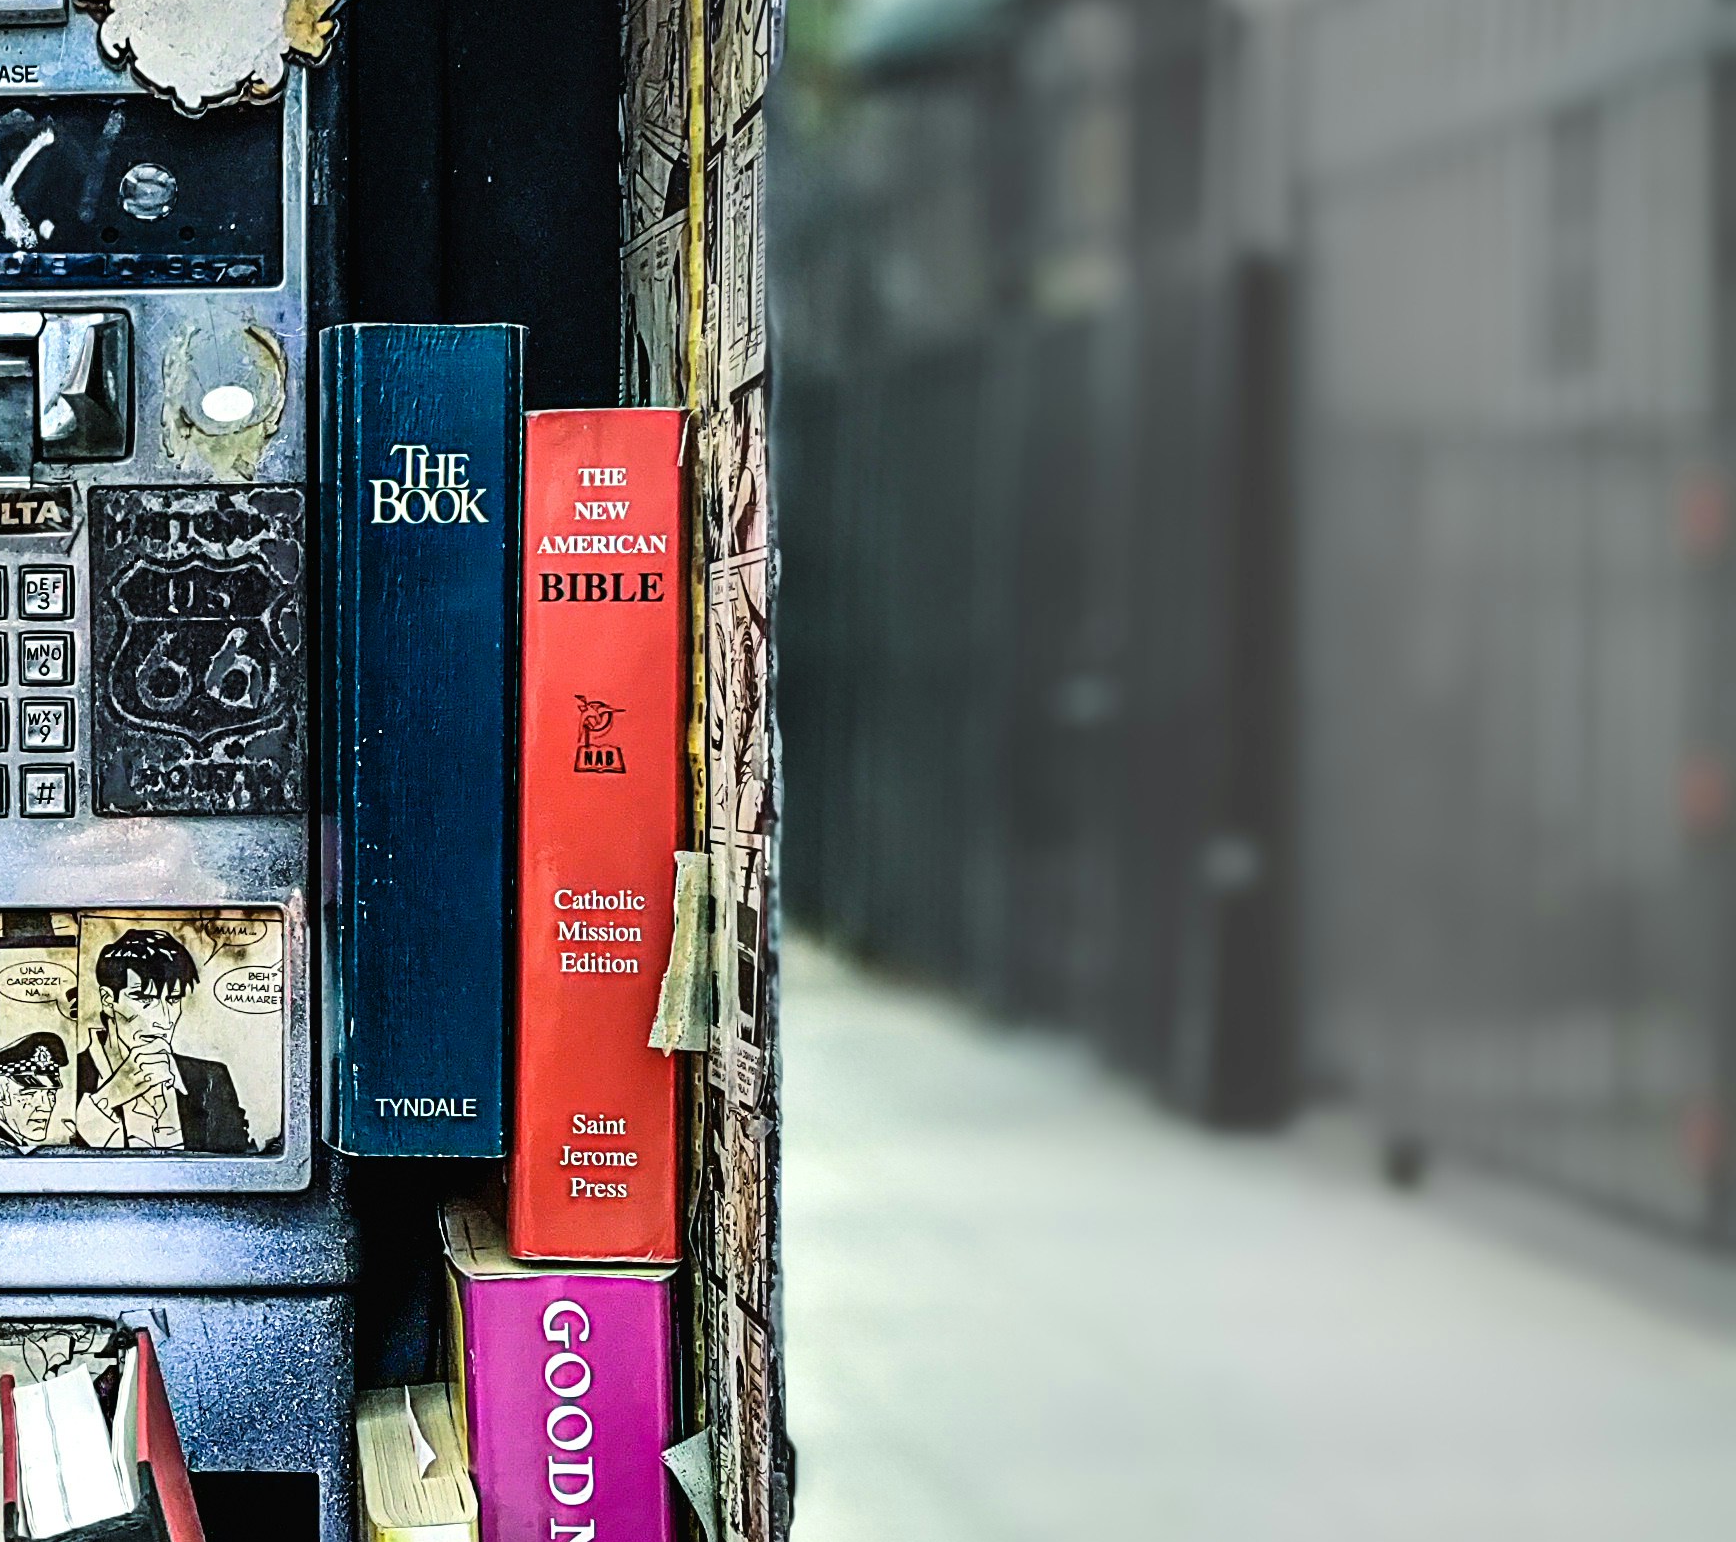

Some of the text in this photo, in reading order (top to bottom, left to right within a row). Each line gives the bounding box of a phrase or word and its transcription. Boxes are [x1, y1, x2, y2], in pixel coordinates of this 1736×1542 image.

[390, 444, 470, 489] THE
[578, 468, 627, 487] THE
[371, 480, 489, 524] BOOK
[575, 501, 630, 520] NEW
[537, 535, 667, 555] AMERICAN
[27, 578, 61, 595] DEF
[538, 572, 664, 602] BIBLE
[37, 593, 50, 610] 3
[27, 645, 61, 660] MNO
[39, 660, 50, 676] 6
[28, 711, 62, 725] WXY
[40, 726, 51, 743] 9
[583, 750, 615, 766] NAB
[554, 889, 645, 911] Catholic
[558, 922, 642, 942] Mission
[19, 967, 45, 975] UNA
[561, 953, 639, 974] Edition
[376, 1098, 477, 1117] TYNDALE
[572, 1115, 626, 1135] Saint
[560, 1145, 638, 1168] Jerome
[570, 1178, 628, 1198] Press
[542, 1299, 594, 1506] GOOD
